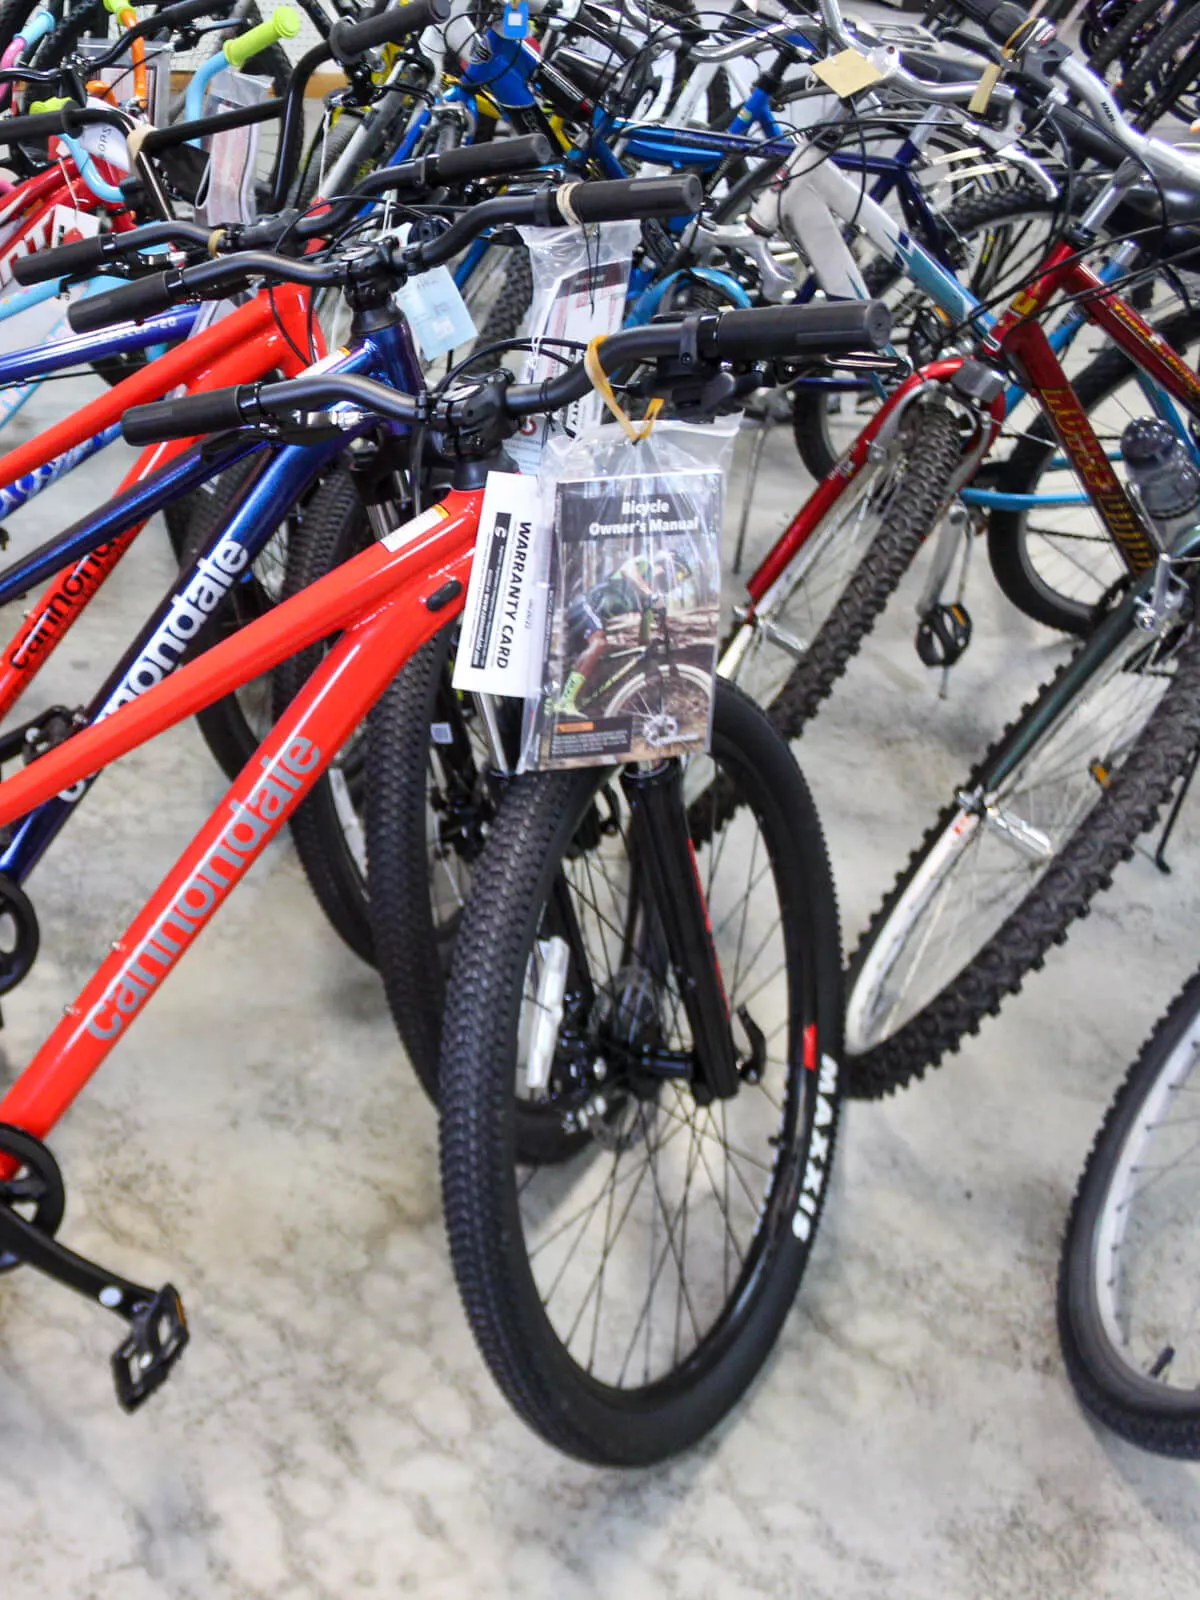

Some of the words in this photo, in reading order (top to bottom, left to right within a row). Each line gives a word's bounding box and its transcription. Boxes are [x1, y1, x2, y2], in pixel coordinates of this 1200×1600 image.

[588, 519, 647, 536] Owner's
[648, 516, 699, 532] Manual
[621, 499, 669, 516] Bicycle
[505, 521, 532, 621] WARRANTY
[496, 624, 515, 670] CARD
[86, 735, 321, 1040] cannondale
[792, 1053, 839, 1242] MAXXIS
